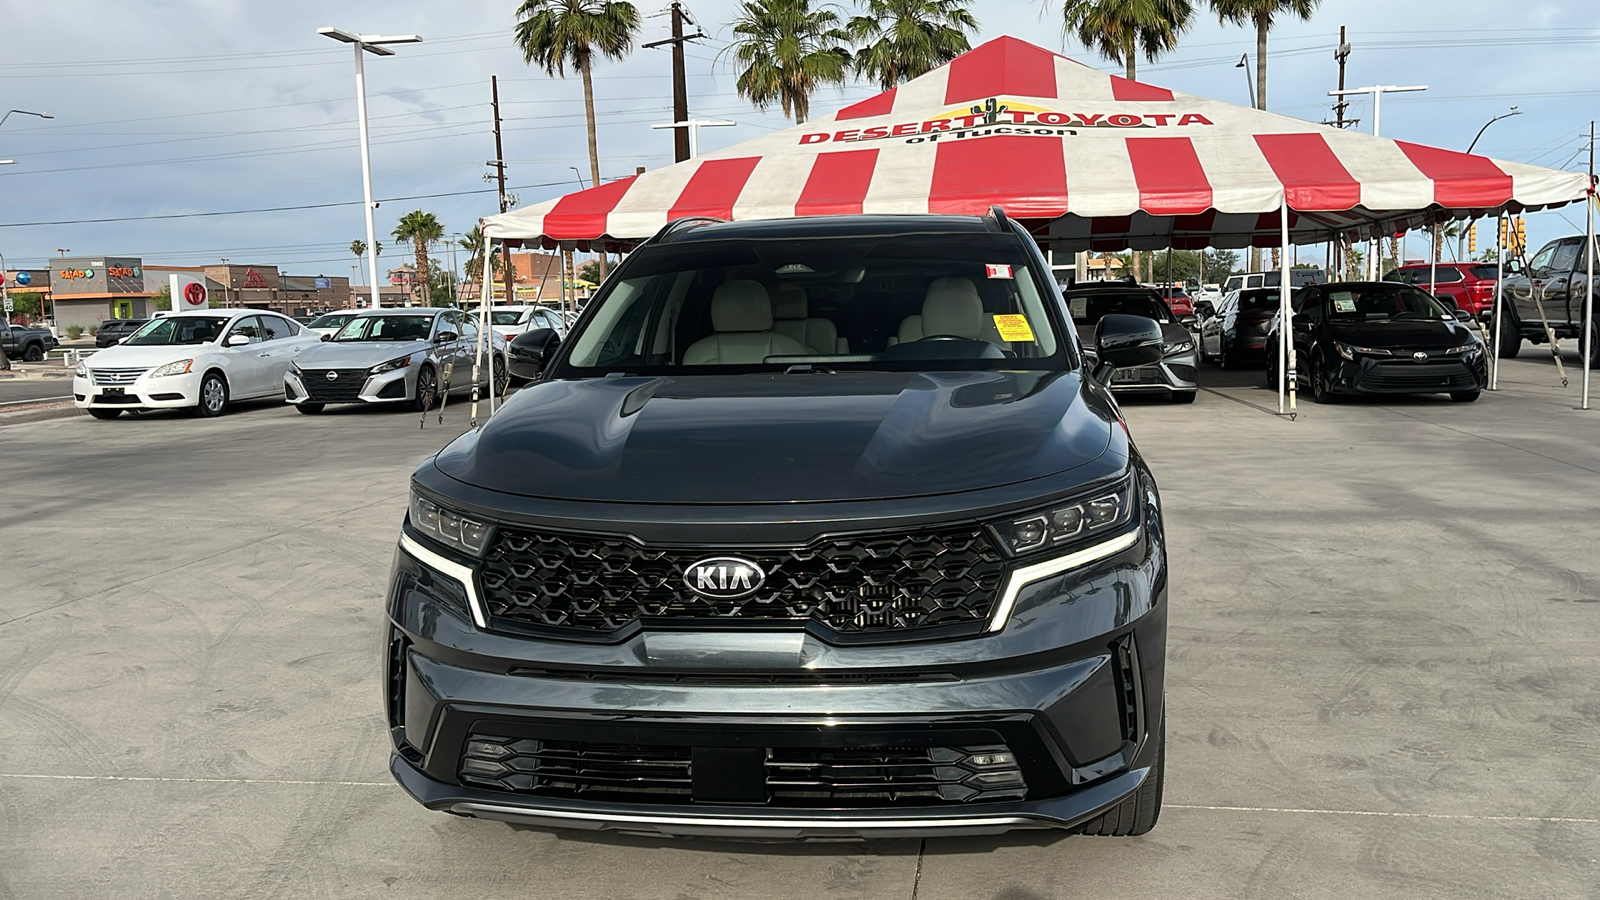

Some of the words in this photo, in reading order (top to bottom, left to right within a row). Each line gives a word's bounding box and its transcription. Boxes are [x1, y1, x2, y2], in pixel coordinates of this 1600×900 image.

[798, 112, 985, 145] DESERT
[1003, 110, 1215, 127] TOYOTA
[905, 134, 942, 144] of
[949, 127, 1078, 139] Tucson
[697, 566, 752, 589] KIA
